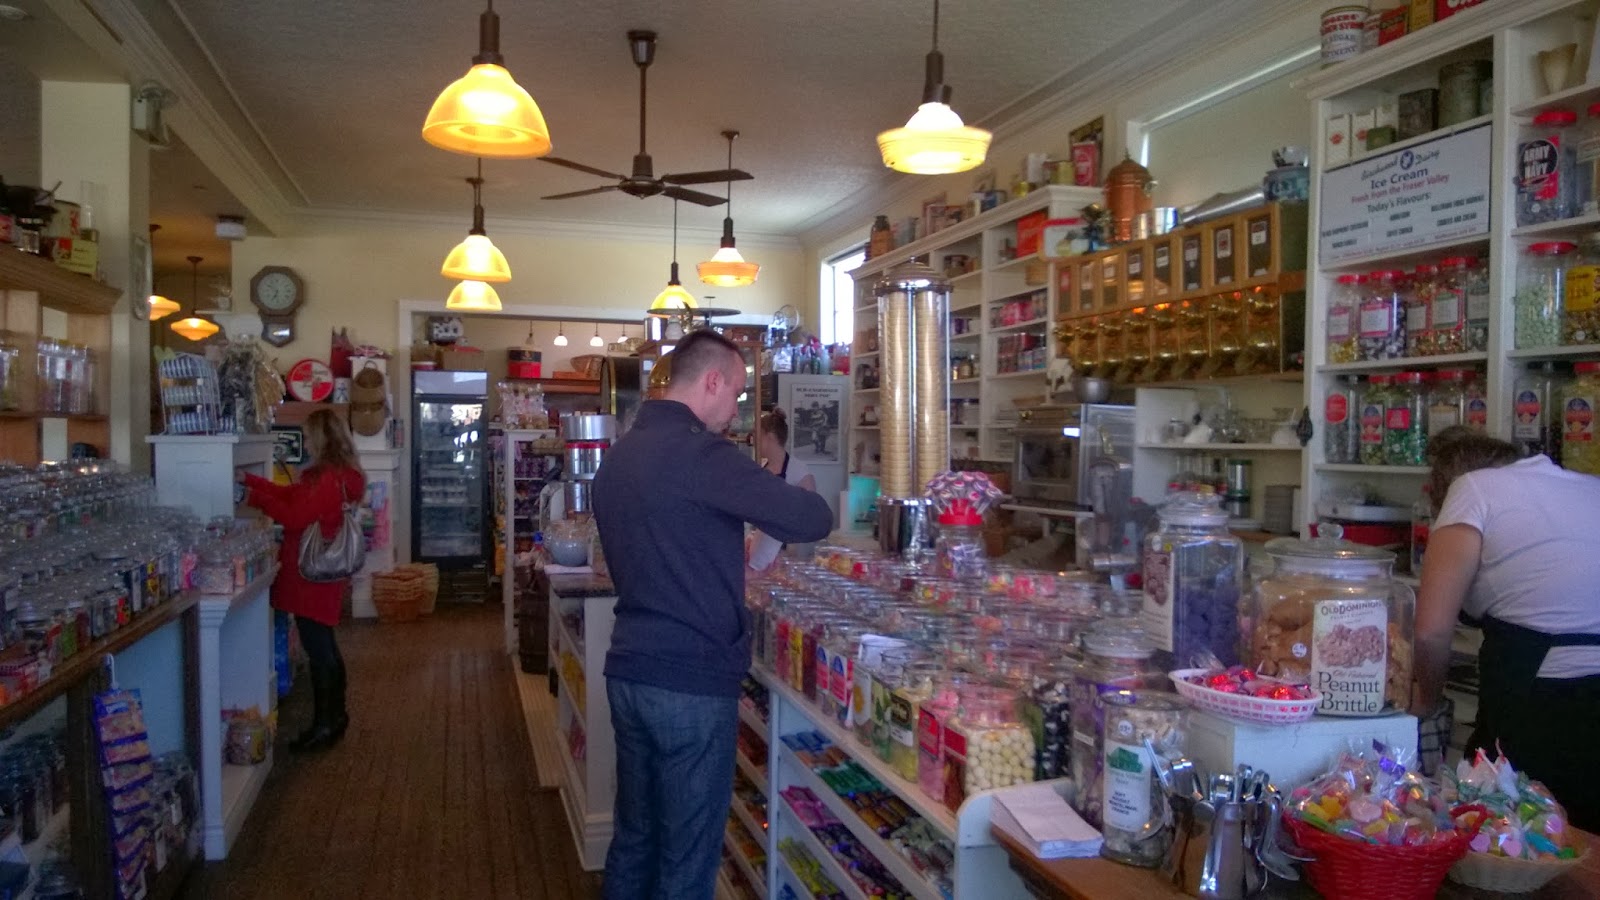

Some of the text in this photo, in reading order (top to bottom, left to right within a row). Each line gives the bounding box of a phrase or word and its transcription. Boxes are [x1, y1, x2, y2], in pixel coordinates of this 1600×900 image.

[1524, 144, 1550, 162] ARMY
[1371, 168, 1428, 190] Ice Cream
[1525, 162, 1548, 179] NAVY
[1371, 190, 1387, 199] from
[1389, 185, 1401, 194] the
[1402, 180, 1425, 190] Fraser
[1426, 174, 1450, 185] Valley
[1317, 671, 1380, 693] Peanut
[1320, 691, 1377, 712] Brittle
